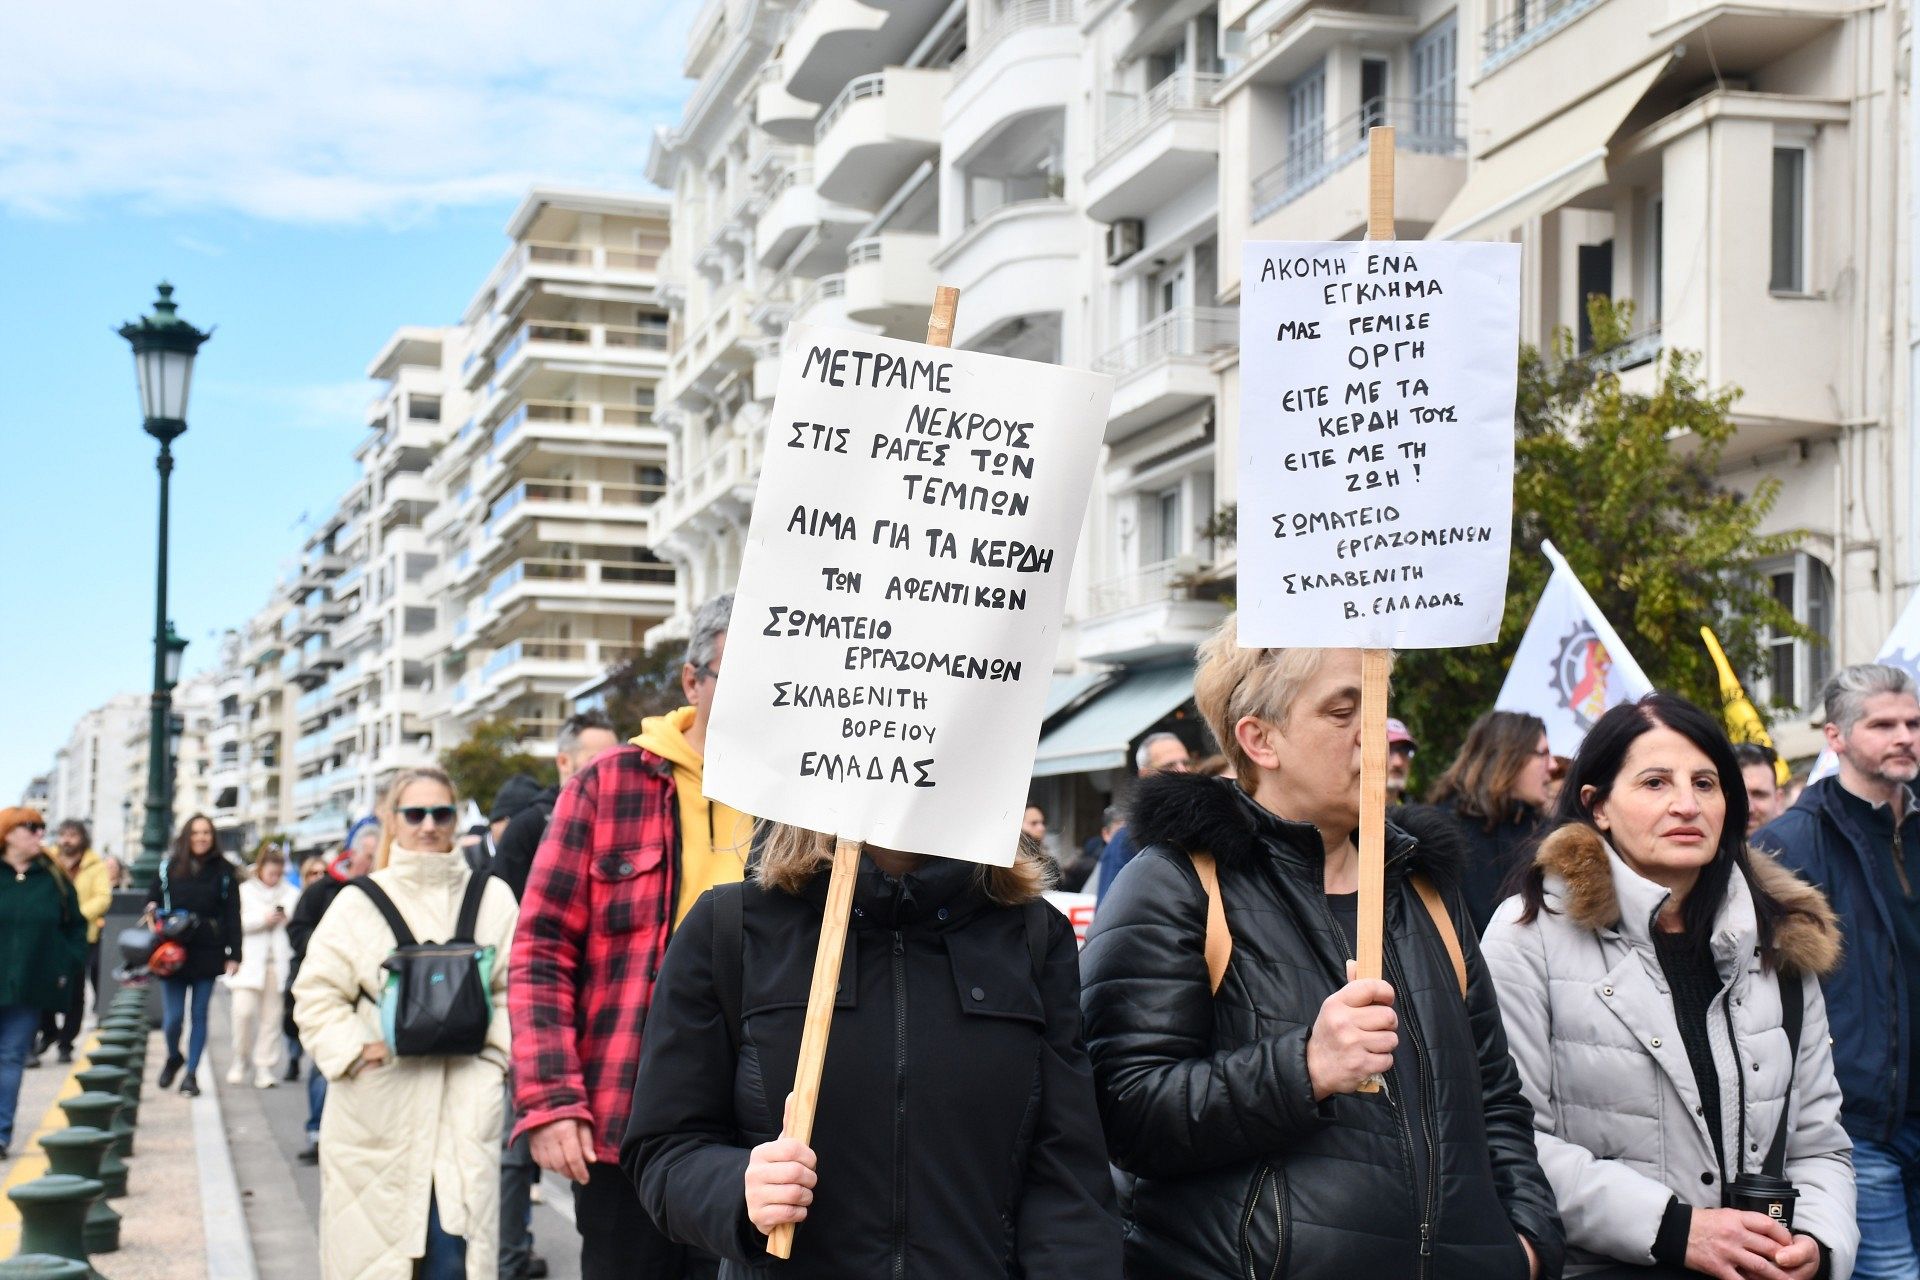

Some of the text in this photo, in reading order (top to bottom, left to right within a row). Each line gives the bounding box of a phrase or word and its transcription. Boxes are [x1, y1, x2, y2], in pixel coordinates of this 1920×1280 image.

[1260, 254, 1418, 283] ΑΚΟΜΗ ΕΝΑ
[1323, 279, 1443, 305] ΕΓΚΛΗΜΑ
[1277, 312, 1430, 342] ΜΑΣ ΓΕΜΙΣΕ
[801, 345, 954, 394] ΜΕΤΡΑΜΕ
[1348, 340, 1425, 370] ΟΡΓΗ
[1344, 380, 1382, 405] ΜΕ
[1396, 378, 1429, 399] ΤΑ
[904, 404, 1035, 449] ΝΕΚΡΟΥΣ
[1318, 405, 1458, 438] ΚΕΡΔΗ ΤΟΥΣ
[787, 421, 1035, 480] ΣΤΙΣ ΡΑΓΕΣ ΤΩΝ
[1347, 443, 1385, 464] ΜΕ
[1397, 441, 1427, 459] ΤΗ
[1345, 468, 1400, 492] ΖΩΗ
[902, 474, 1029, 517] ΤΕΜΠΩΝ
[1272, 505, 1400, 539] ΣΩΜΑΤΕΙΟ
[786, 504, 1054, 574] ΑΙΜΑ ΓΙΑ ΤΑ ΚΕΡΔΗ
[821, 567, 1027, 611] ΤΩΝ ΑΦΕΝΤΙΚΩΝ
[1282, 565, 1424, 595] ΣΚΛΑΒΕΝΙΤΗ
[762, 606, 892, 640] ΣΩΜΑΤΕΙΟ
[772, 681, 928, 710] ΣΚΛΑΒΕΝΙΤΗ
[842, 717, 936, 744] ΒΟΡΕΙΟΥ
